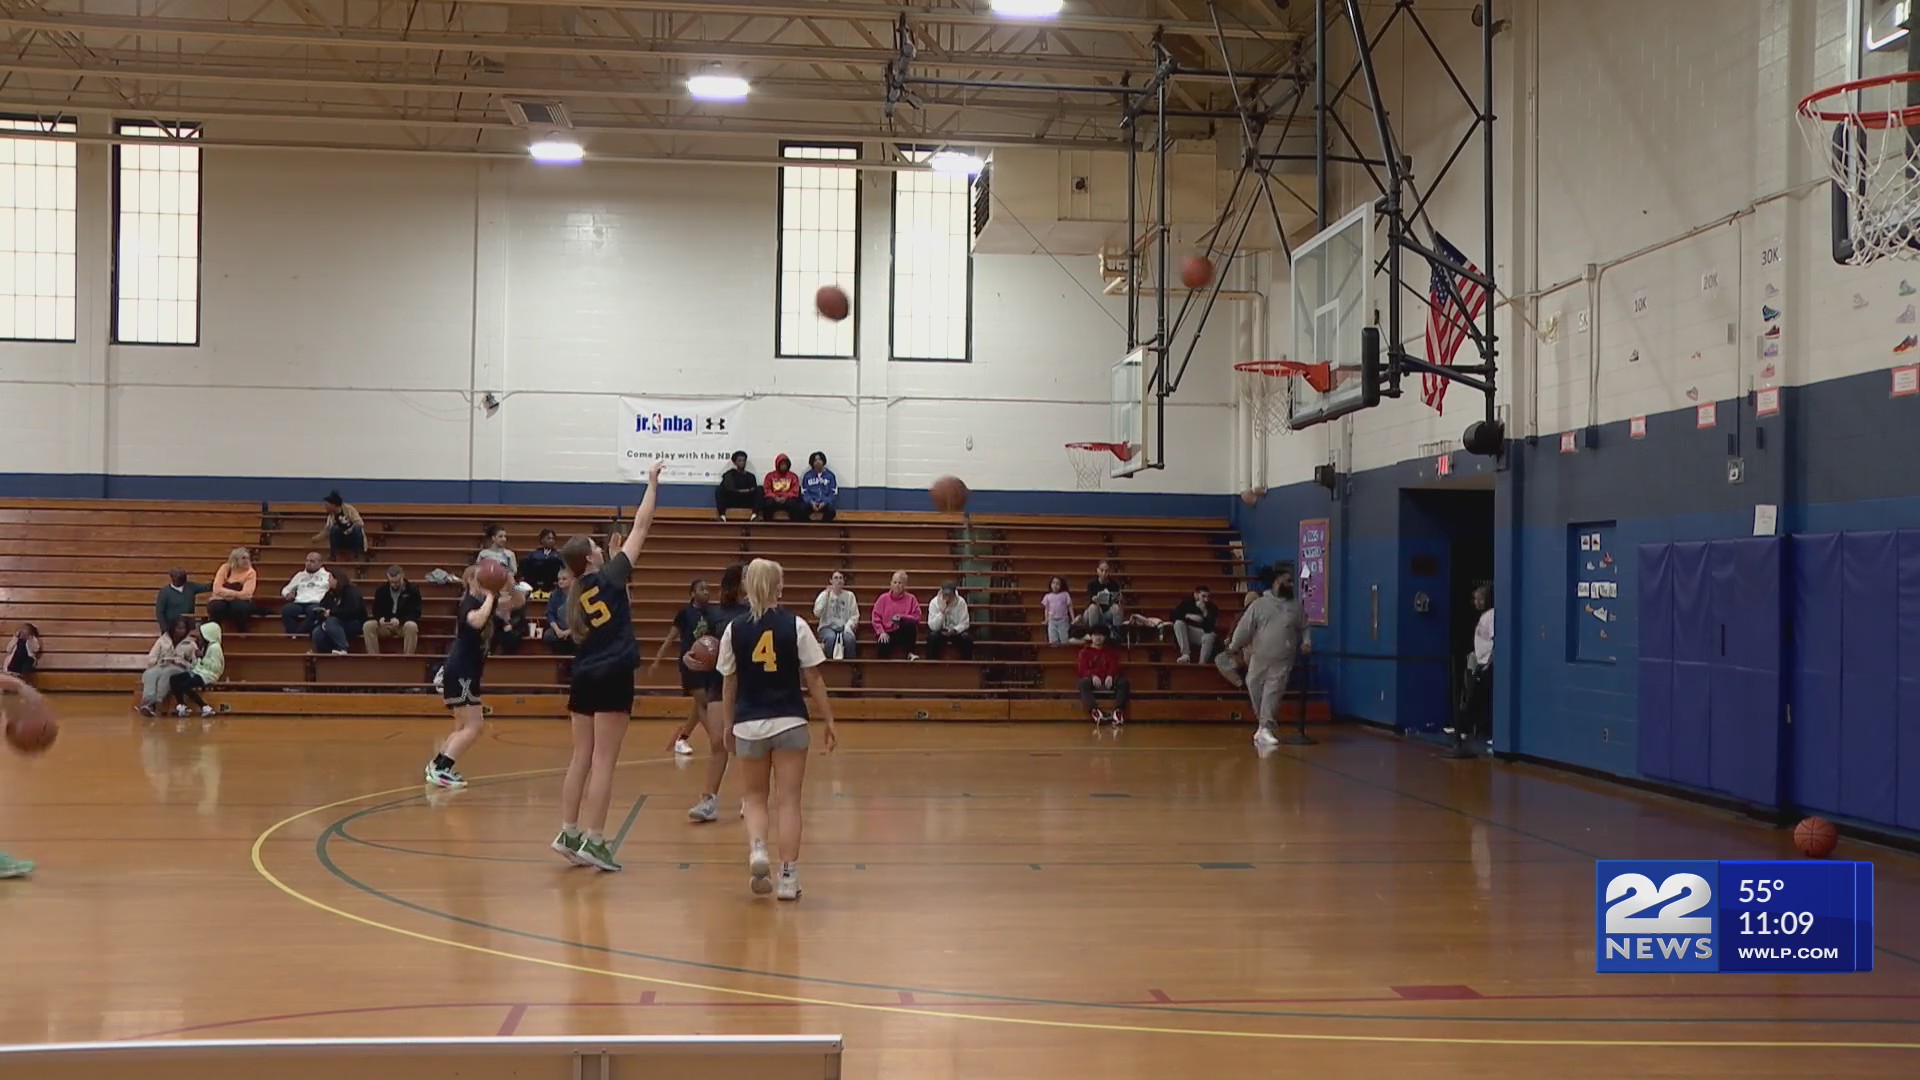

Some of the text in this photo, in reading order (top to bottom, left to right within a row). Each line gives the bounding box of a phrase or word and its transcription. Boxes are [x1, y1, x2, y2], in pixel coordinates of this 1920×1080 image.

[1761, 247, 1779, 266] 30K
[1703, 273, 1719, 290] 20K
[1634, 297, 1647, 312] 10K
[636, 414, 692, 432] jr. nba
[627, 450, 731, 460] Come play with the NB
[580, 585, 611, 628] 5
[752, 630, 777, 672] 4
